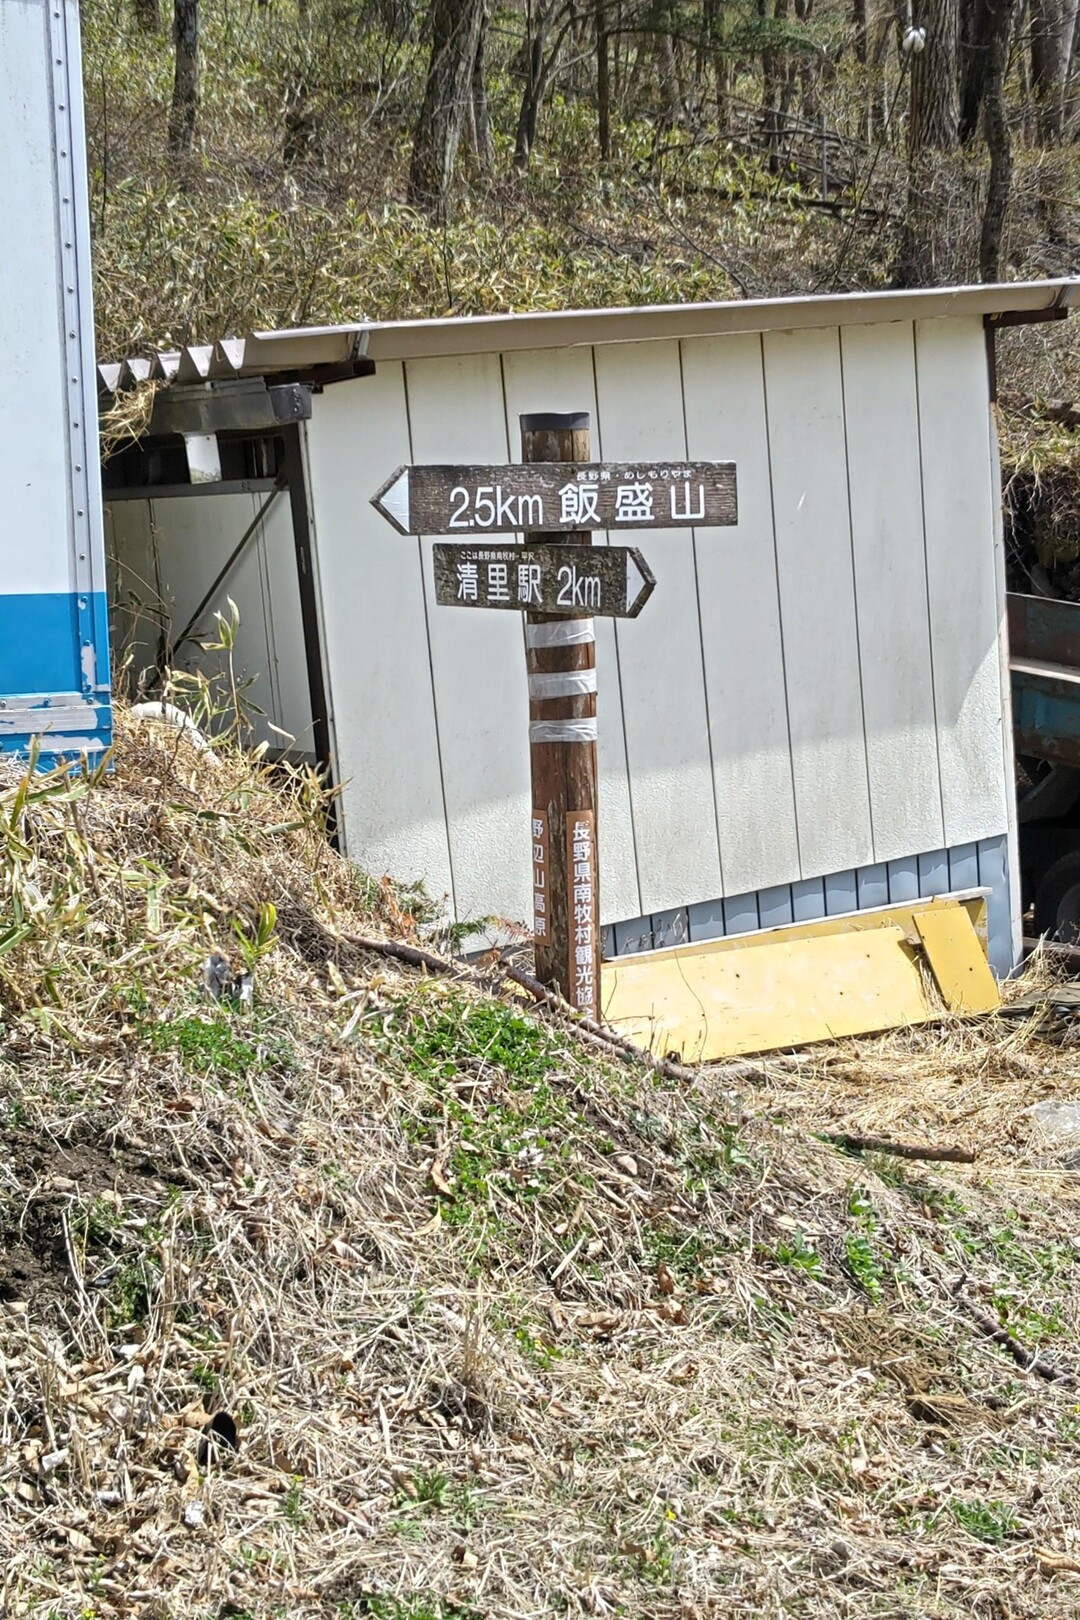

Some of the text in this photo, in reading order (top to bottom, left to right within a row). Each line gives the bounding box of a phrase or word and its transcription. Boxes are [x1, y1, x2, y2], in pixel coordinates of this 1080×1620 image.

[449, 481, 705, 527] 2.5km 飯盛山
[456, 562, 601, 607] 清里駅 2km
